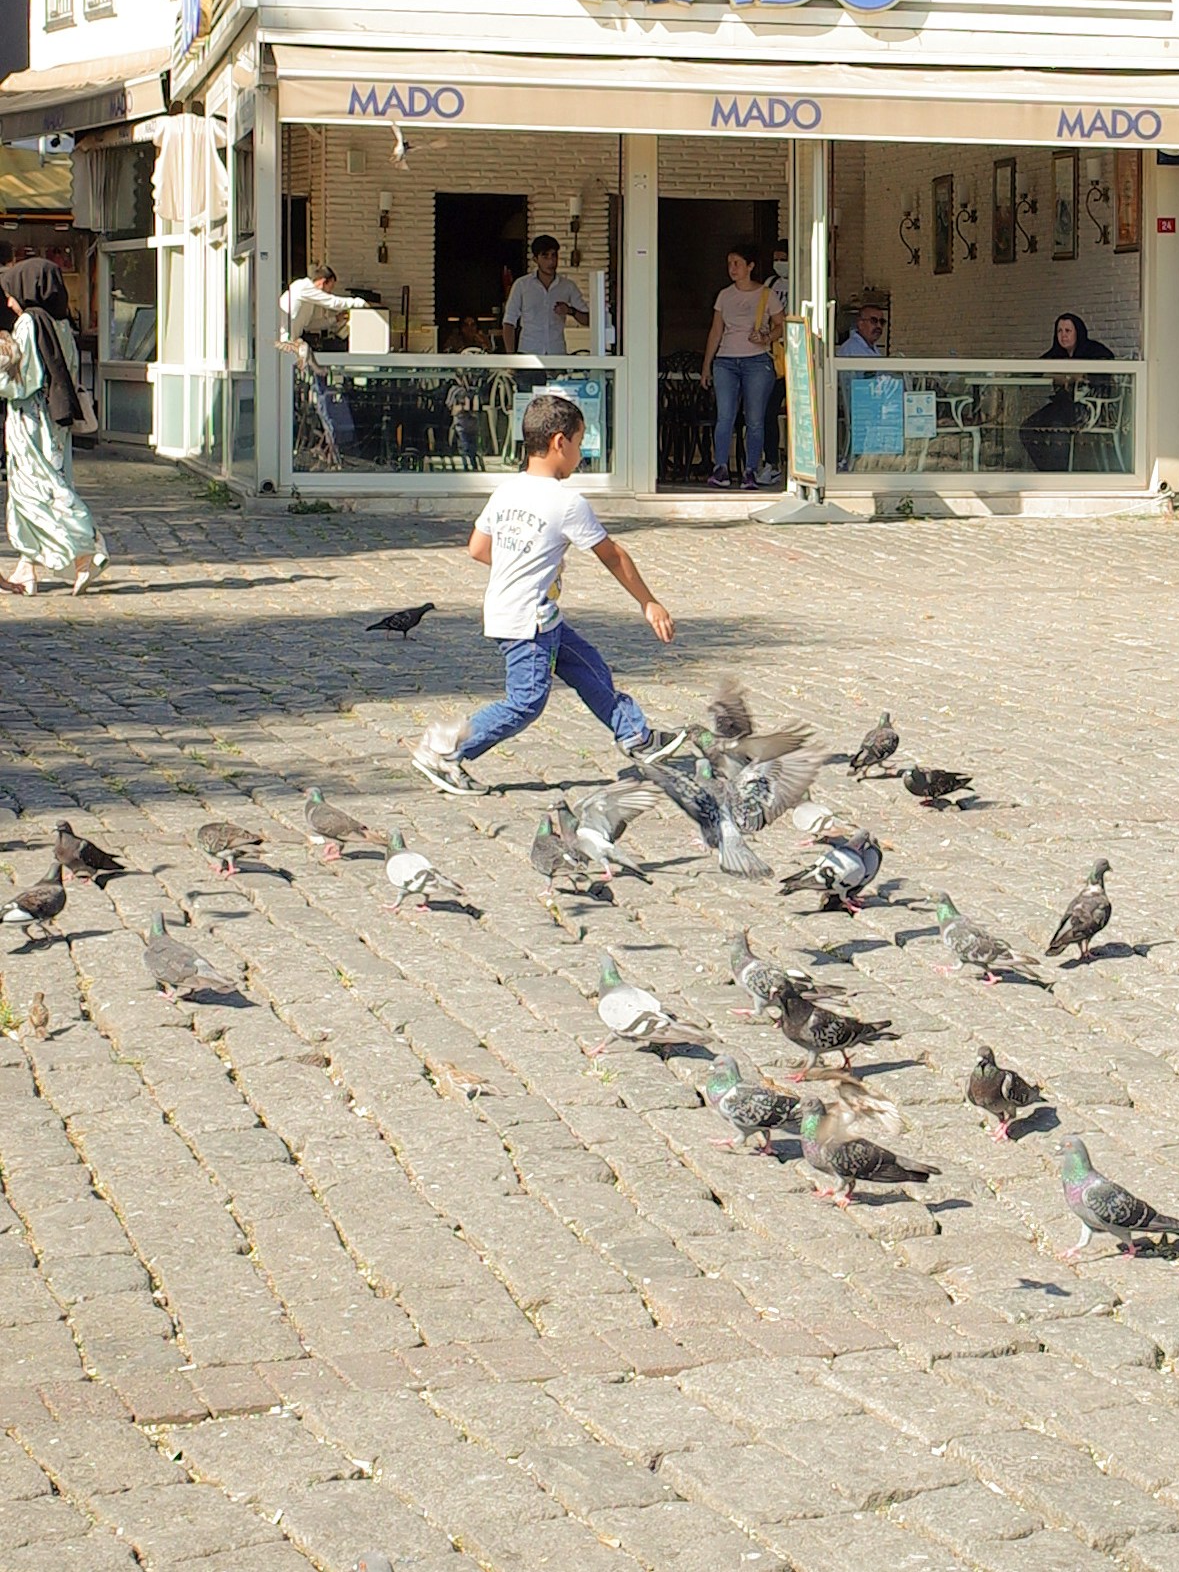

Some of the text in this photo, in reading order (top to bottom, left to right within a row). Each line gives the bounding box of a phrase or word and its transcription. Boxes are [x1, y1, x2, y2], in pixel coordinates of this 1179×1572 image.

[347, 83, 465, 119] MADO
[710, 96, 822, 130] MADO
[1057, 108, 1162, 141] MADO
[1161, 220, 1172, 231] 24
